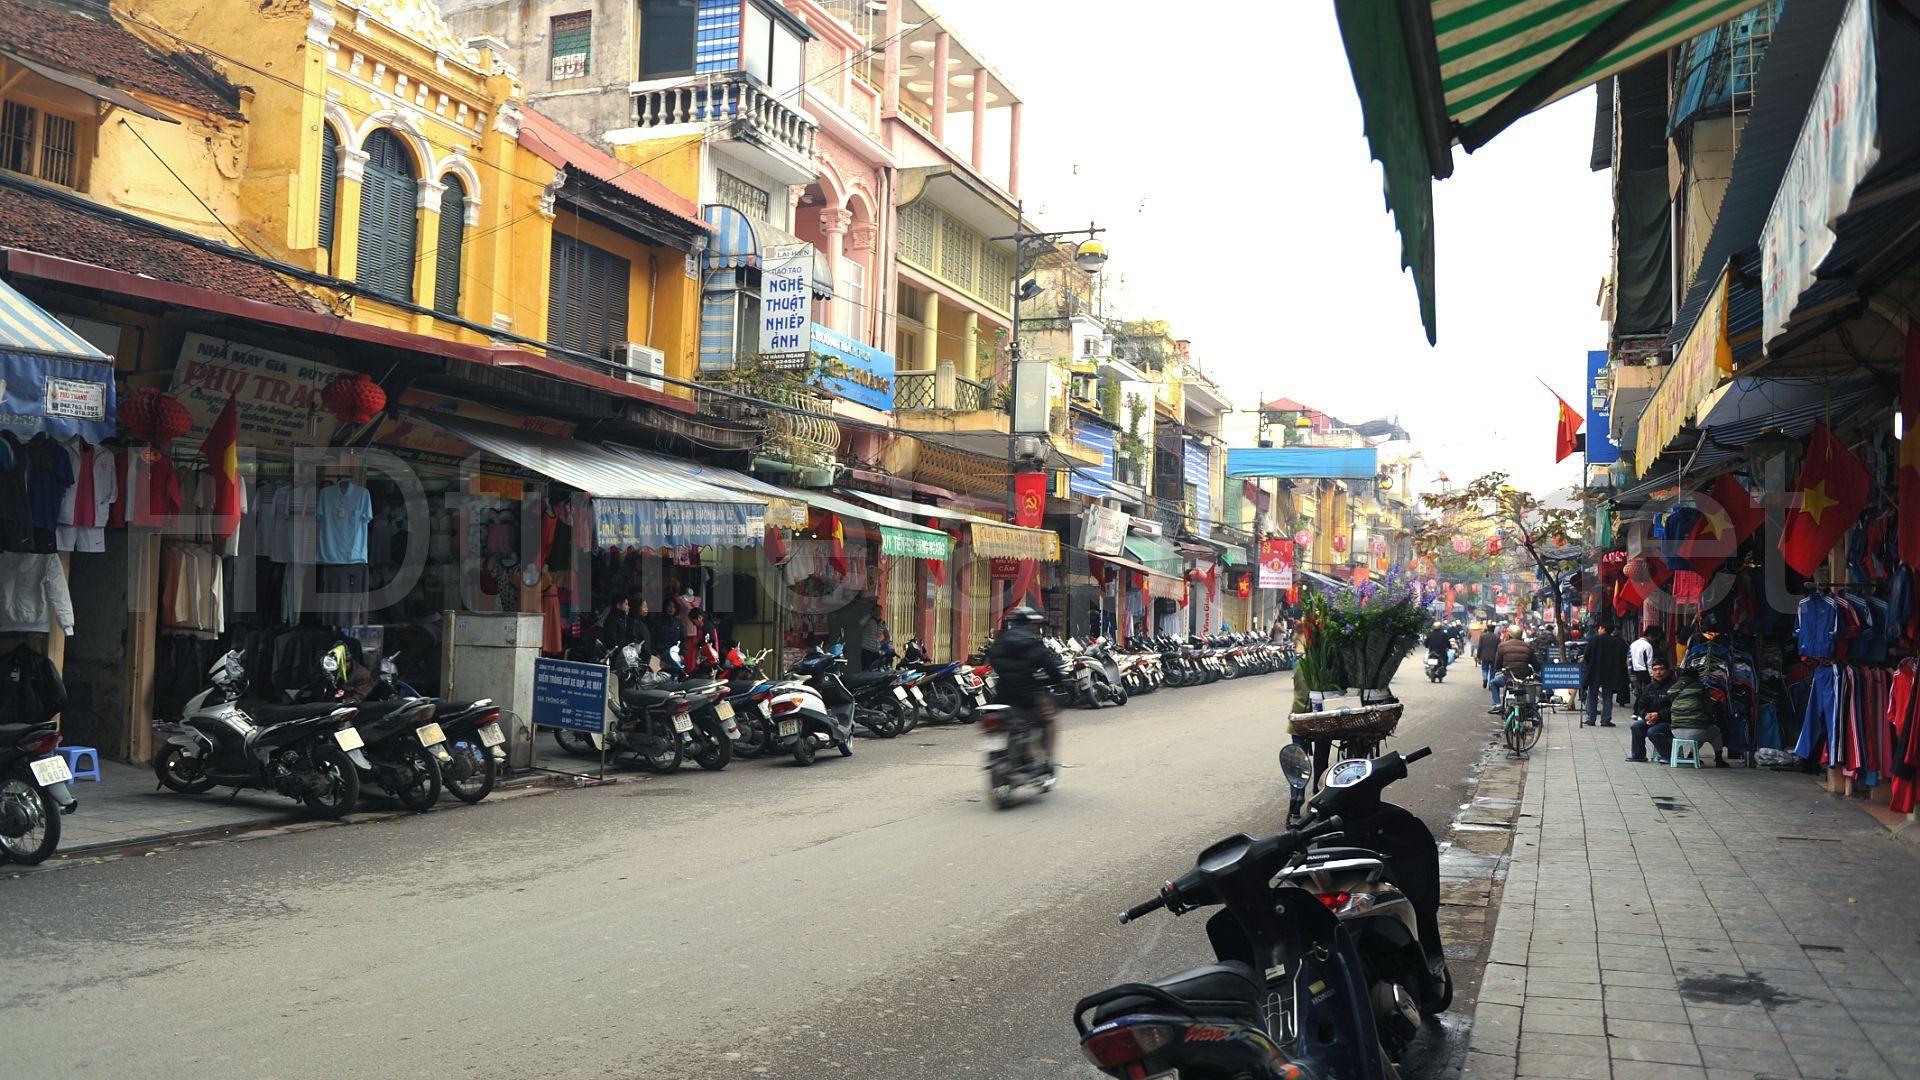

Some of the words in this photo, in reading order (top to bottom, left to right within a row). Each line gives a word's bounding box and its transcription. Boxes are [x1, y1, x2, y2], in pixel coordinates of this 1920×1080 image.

[769, 276, 804, 293] NGHỆ
[766, 294, 806, 312] THUẬT
[766, 313, 805, 331] NHIẾP
[771, 331, 799, 350] ẢNH
[265, 359, 288, 374] GIA
[184, 360, 250, 395] PHÚ
[998, 563, 1016, 571] CẤM
[1311, 988, 1336, 1005] HONDA
[1092, 1022, 1118, 1034] HONDA
